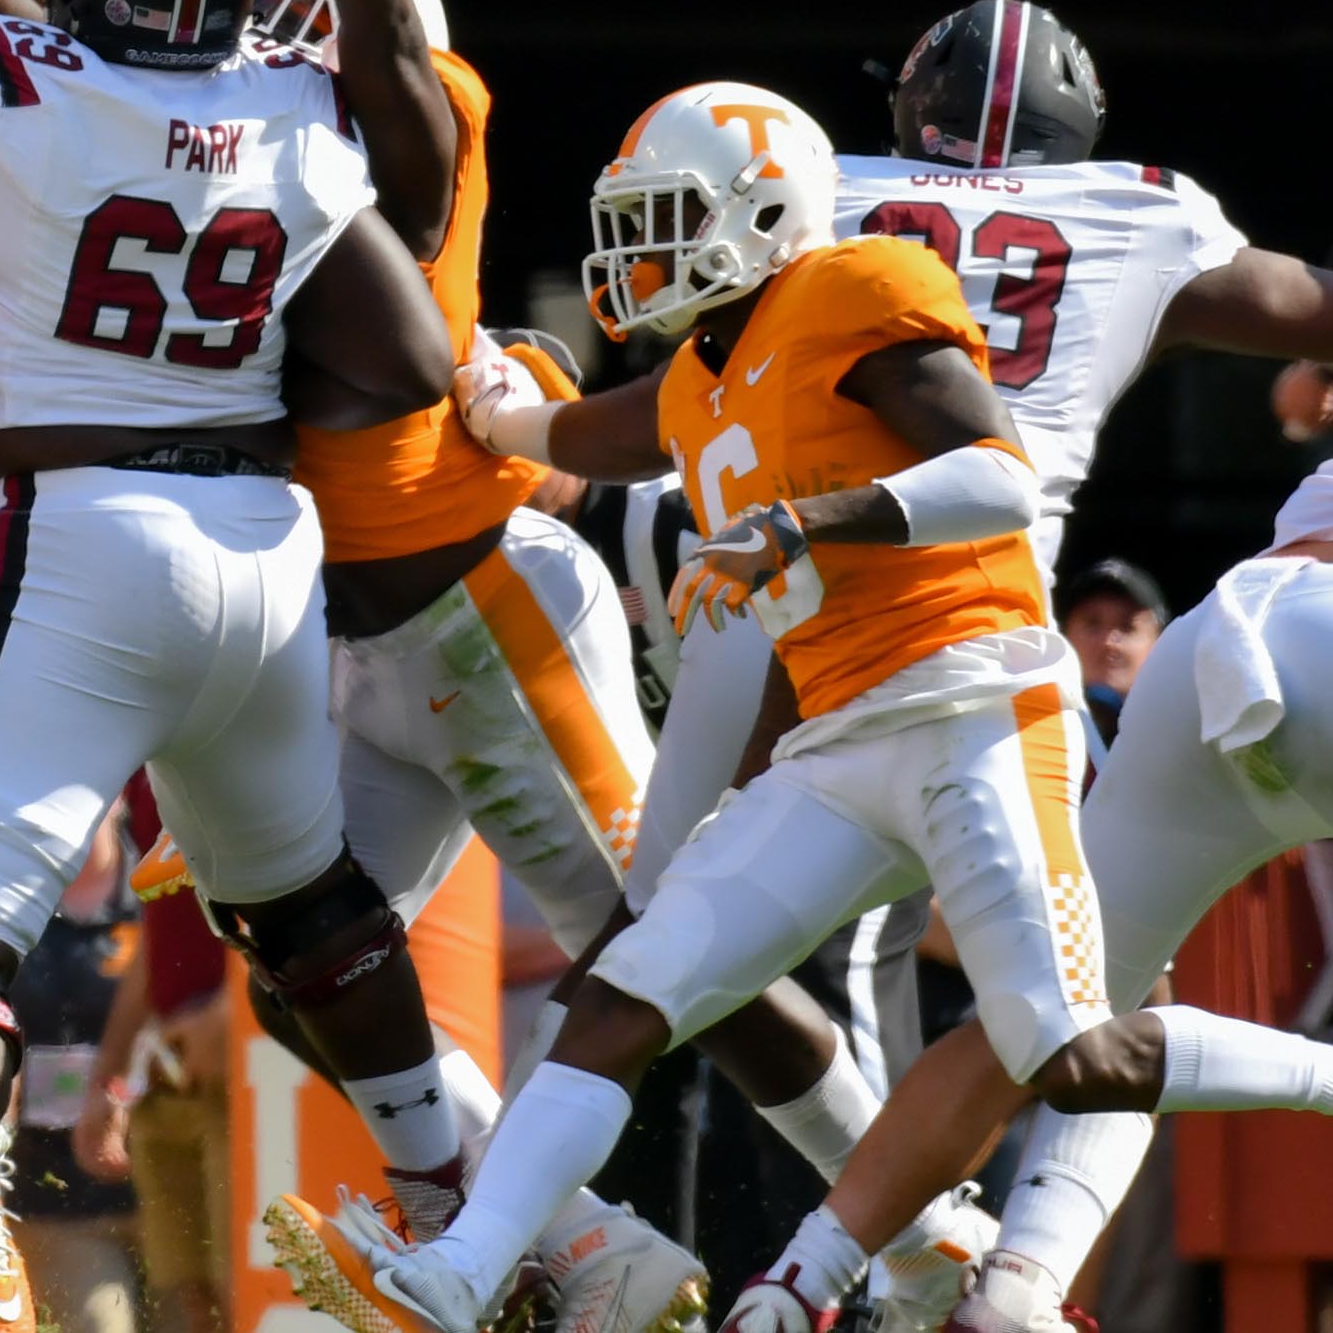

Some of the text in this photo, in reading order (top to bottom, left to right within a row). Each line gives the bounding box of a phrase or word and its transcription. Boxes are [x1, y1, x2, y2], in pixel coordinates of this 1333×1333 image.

[165, 118, 244, 174] PARK
[709, 105, 790, 179] T
[53, 194, 288, 369] 69
